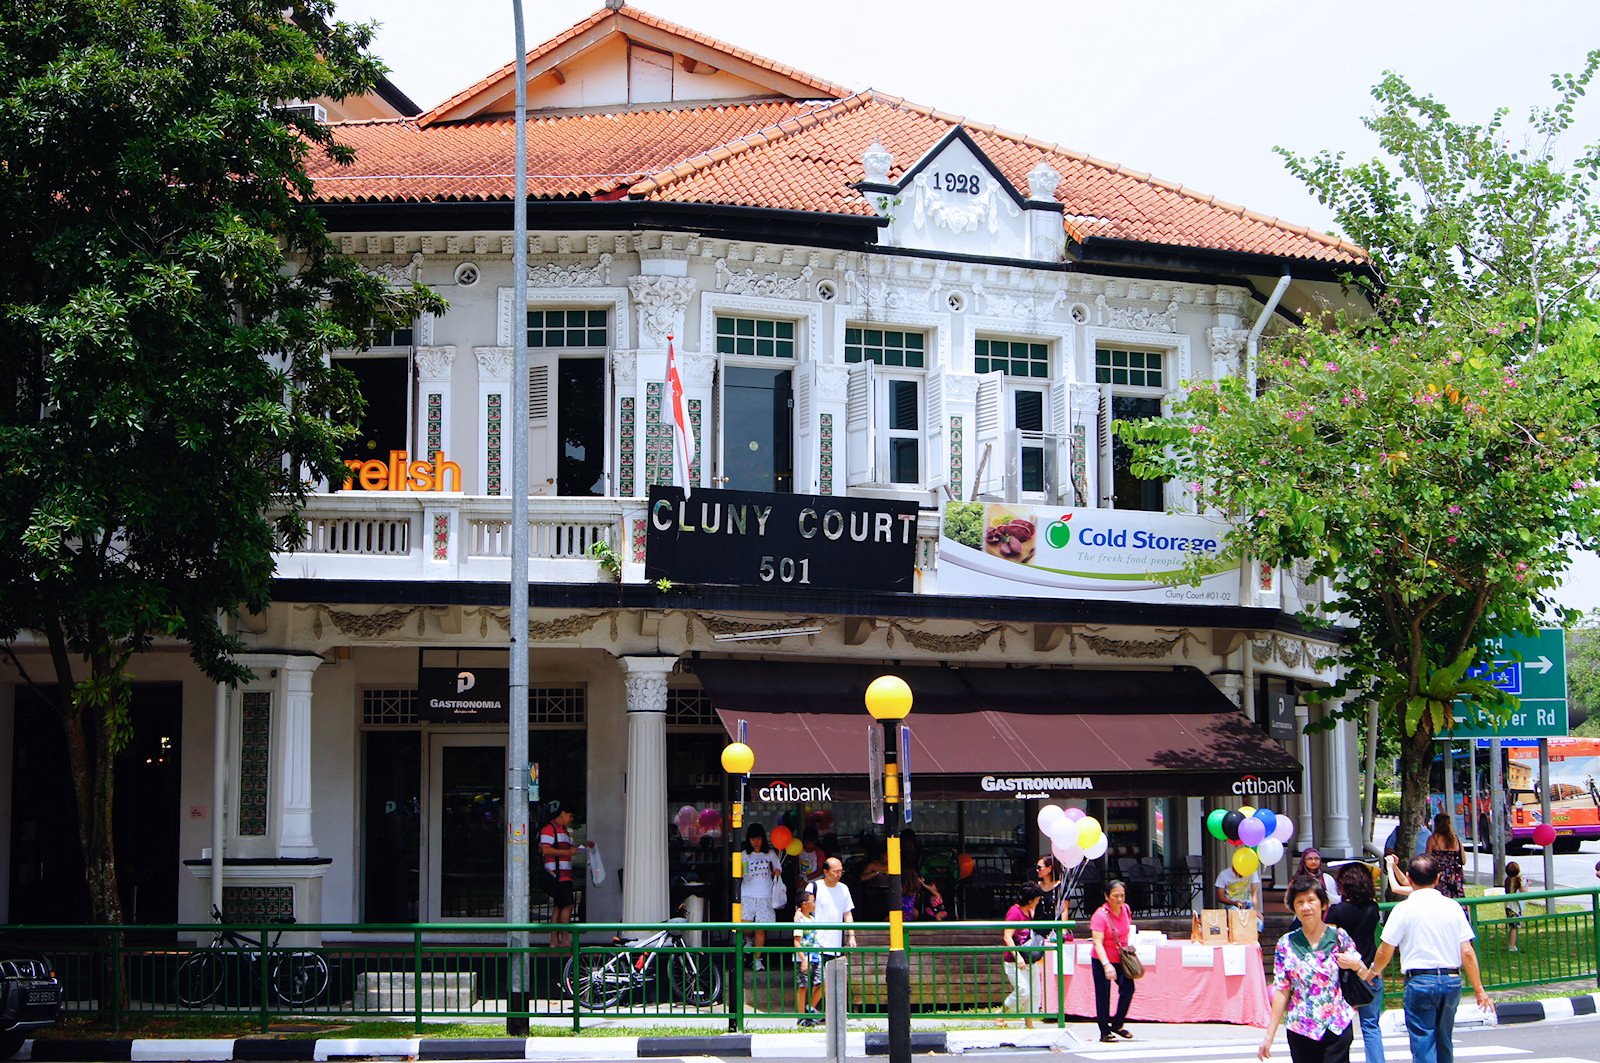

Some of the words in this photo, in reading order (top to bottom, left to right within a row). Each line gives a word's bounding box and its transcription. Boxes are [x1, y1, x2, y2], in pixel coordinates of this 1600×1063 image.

[933, 172, 980, 195] 1928
[343, 450, 461, 491] relish
[652, 499, 773, 536] CLUNY
[799, 508, 916, 544] COURT
[1078, 528, 1127, 548] Cold
[1132, 530, 1217, 555] Storage
[759, 555, 811, 584] 501
[1077, 552, 1095, 562] The
[1098, 552, 1123, 564] fresh
[1126, 554, 1148, 565] food
[1150, 556, 1181, 567] people
[1165, 589, 1184, 600] Cluny
[1186, 590, 1204, 600] Court
[1205, 591, 1231, 601] #01-02
[429, 698, 502, 709] GASTRONOMIA
[1537, 708, 1556, 726] Rd
[759, 781, 832, 802] citibank
[981, 775, 1094, 791] GASTRONOMIA
[1231, 775, 1296, 795] citibank
